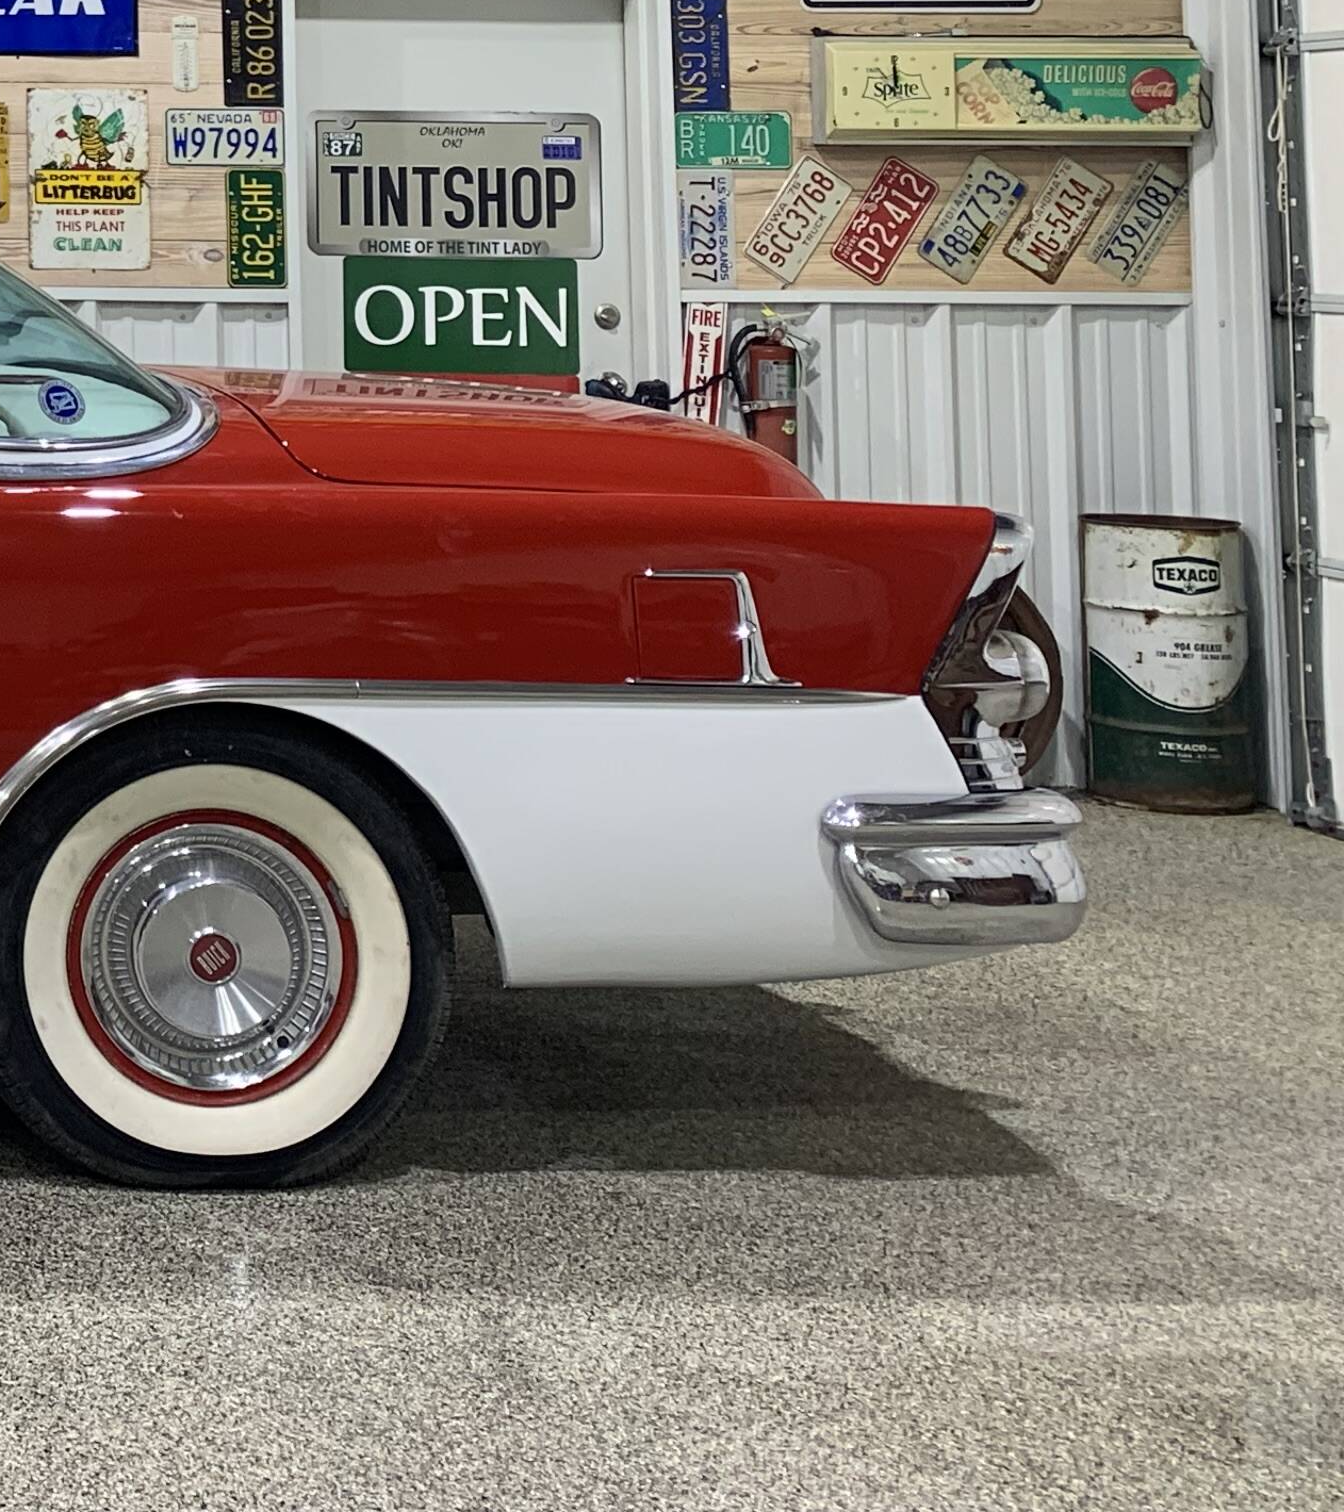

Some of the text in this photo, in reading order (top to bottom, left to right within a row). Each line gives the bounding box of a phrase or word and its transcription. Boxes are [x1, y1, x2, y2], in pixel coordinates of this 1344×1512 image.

[1043, 63, 1127, 85] DELICIOUS
[196, 113, 252, 124] NEVADA
[419, 126, 486, 136] OKLAHOMA
[173, 127, 278, 160] W97994
[729, 125, 770, 157] 140
[96, 174, 116, 182] BE
[42, 184, 137, 201] LITTERBUG
[331, 166, 576, 229] TINTSHOP
[55, 208, 125, 216] HELP KEEP
[56, 220, 126, 233] THIS PLANT
[53, 237, 123, 252] CLEAN
[368, 240, 542, 256] HOME OF THE TINT LADY
[353, 285, 570, 347] OPEN
[692, 308, 721, 327] FIRE
[1156, 567, 1217, 583] TEXACO
[1160, 741, 1208, 753] TEXACO
